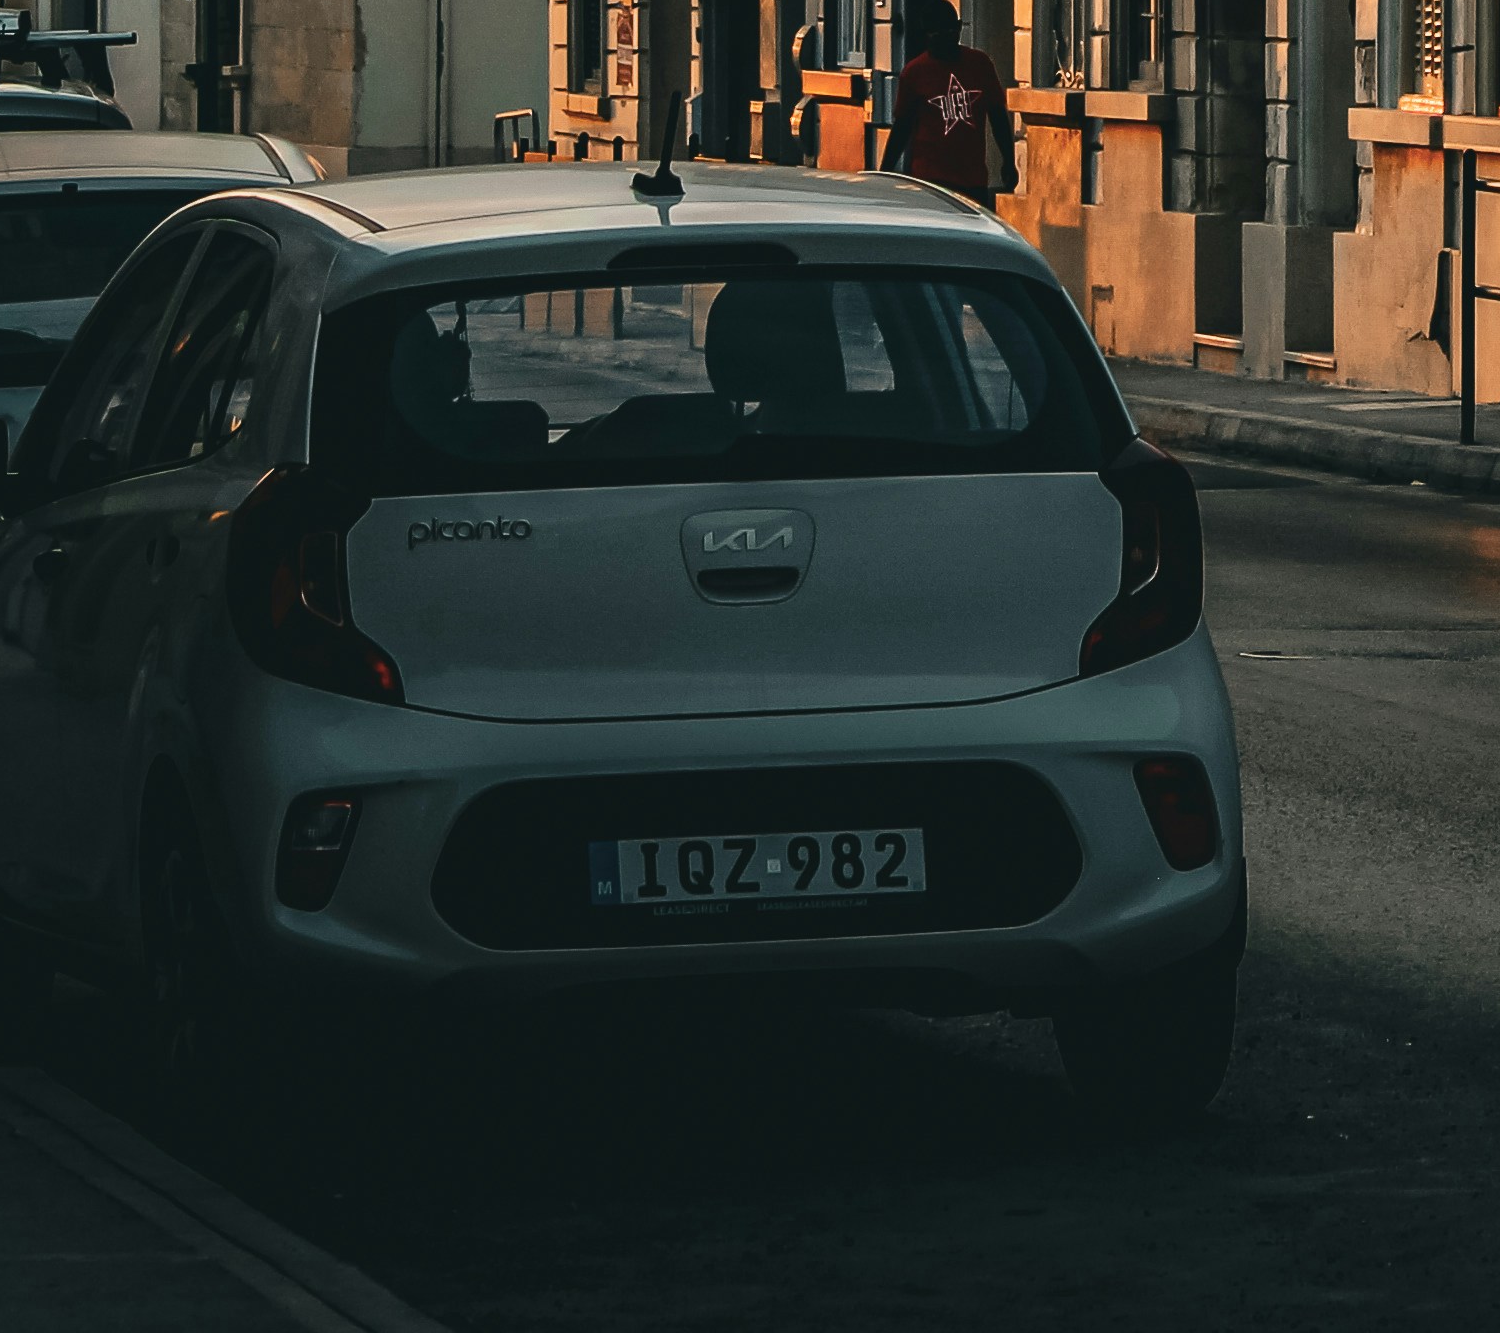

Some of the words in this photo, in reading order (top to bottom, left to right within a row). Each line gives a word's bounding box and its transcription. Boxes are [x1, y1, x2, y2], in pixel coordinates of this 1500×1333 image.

[407, 517, 532, 550] picanto
[637, 837, 760, 898] IQZ
[786, 832, 909, 891] 982
[597, 881, 613, 895] M
